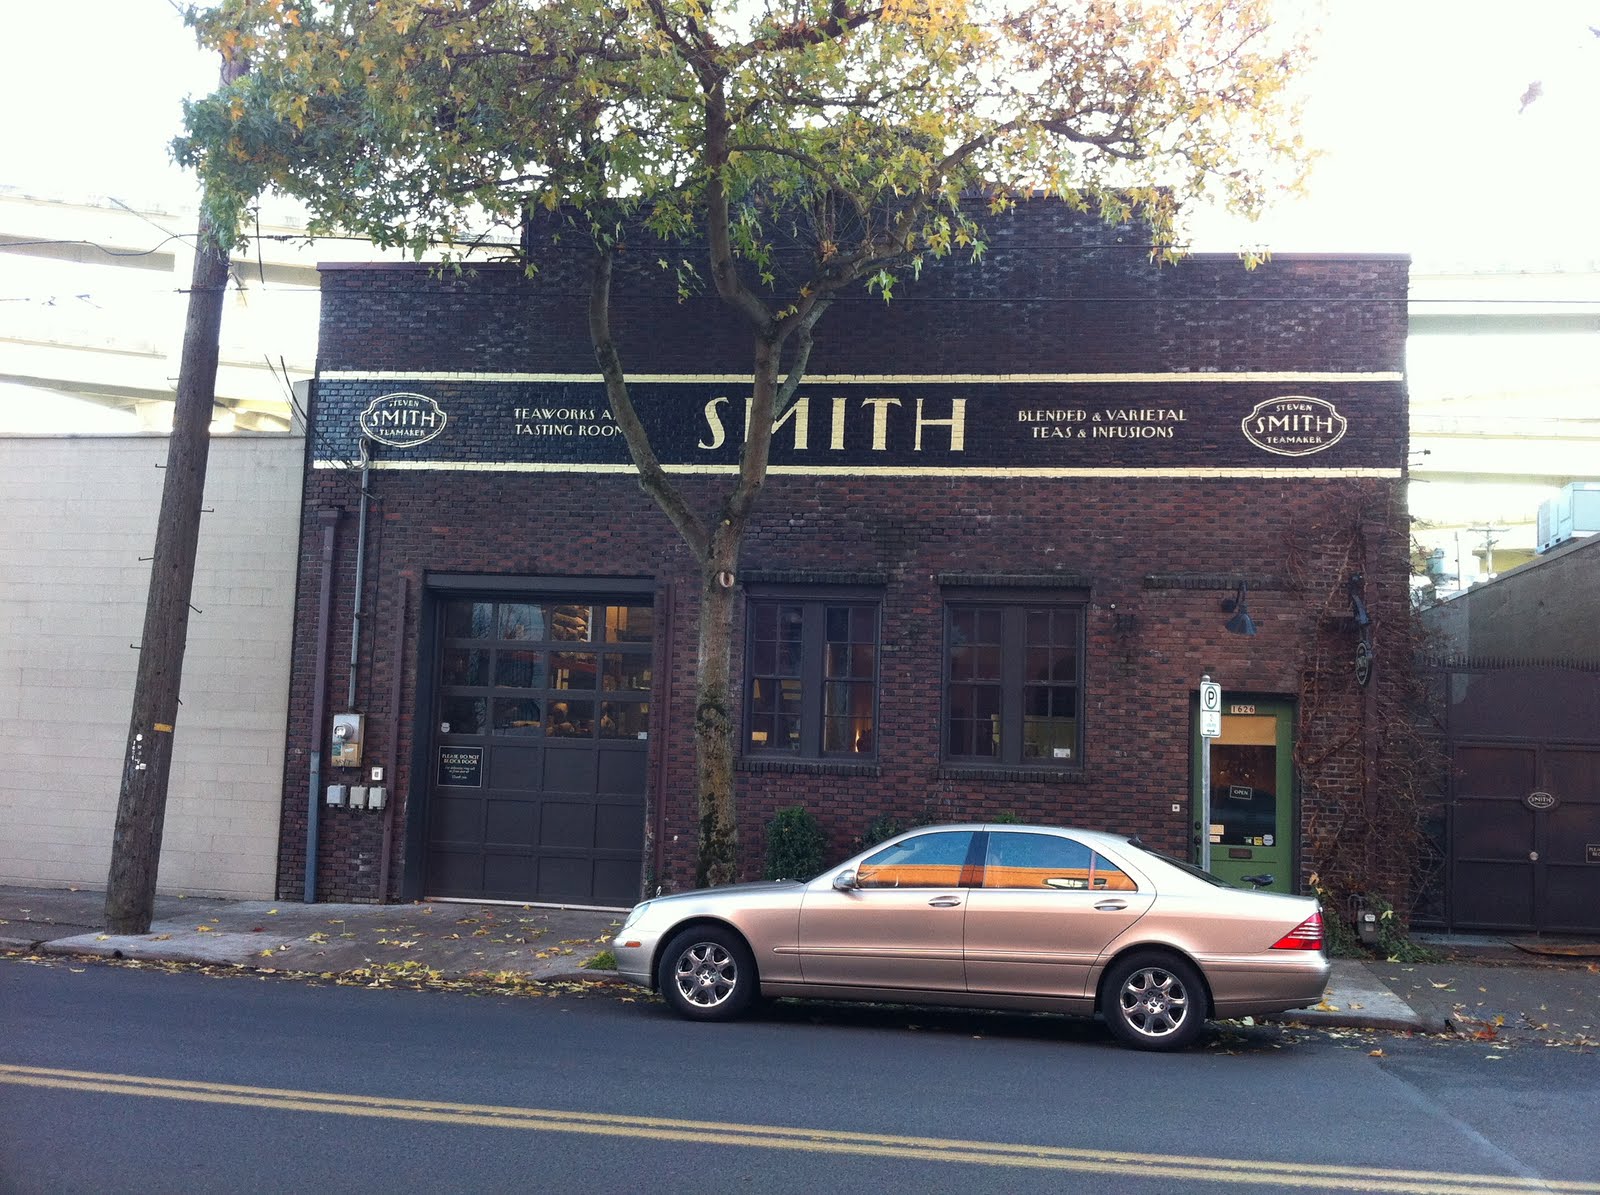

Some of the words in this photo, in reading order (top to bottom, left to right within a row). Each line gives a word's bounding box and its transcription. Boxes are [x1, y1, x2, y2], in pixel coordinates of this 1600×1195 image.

[514, 408, 595, 420] TEAWORKS
[1276, 404, 1313, 412] STEVEN
[371, 410, 435, 427] SMITH
[1018, 410, 1087, 422] BLENDED
[1092, 412, 1101, 422] &
[1106, 409, 1187, 421] VARIETAL
[515, 424, 573, 436] TASTING
[698, 397, 967, 451] SMITH
[1255, 414, 1333, 434] SMITH
[1032, 426, 1072, 438] TEAS
[1077, 429, 1086, 438] &
[1093, 426, 1174, 438] INFUSIONS
[1266, 436, 1322, 444] TEAMAKER
[1232, 705, 1254, 713] 1626
